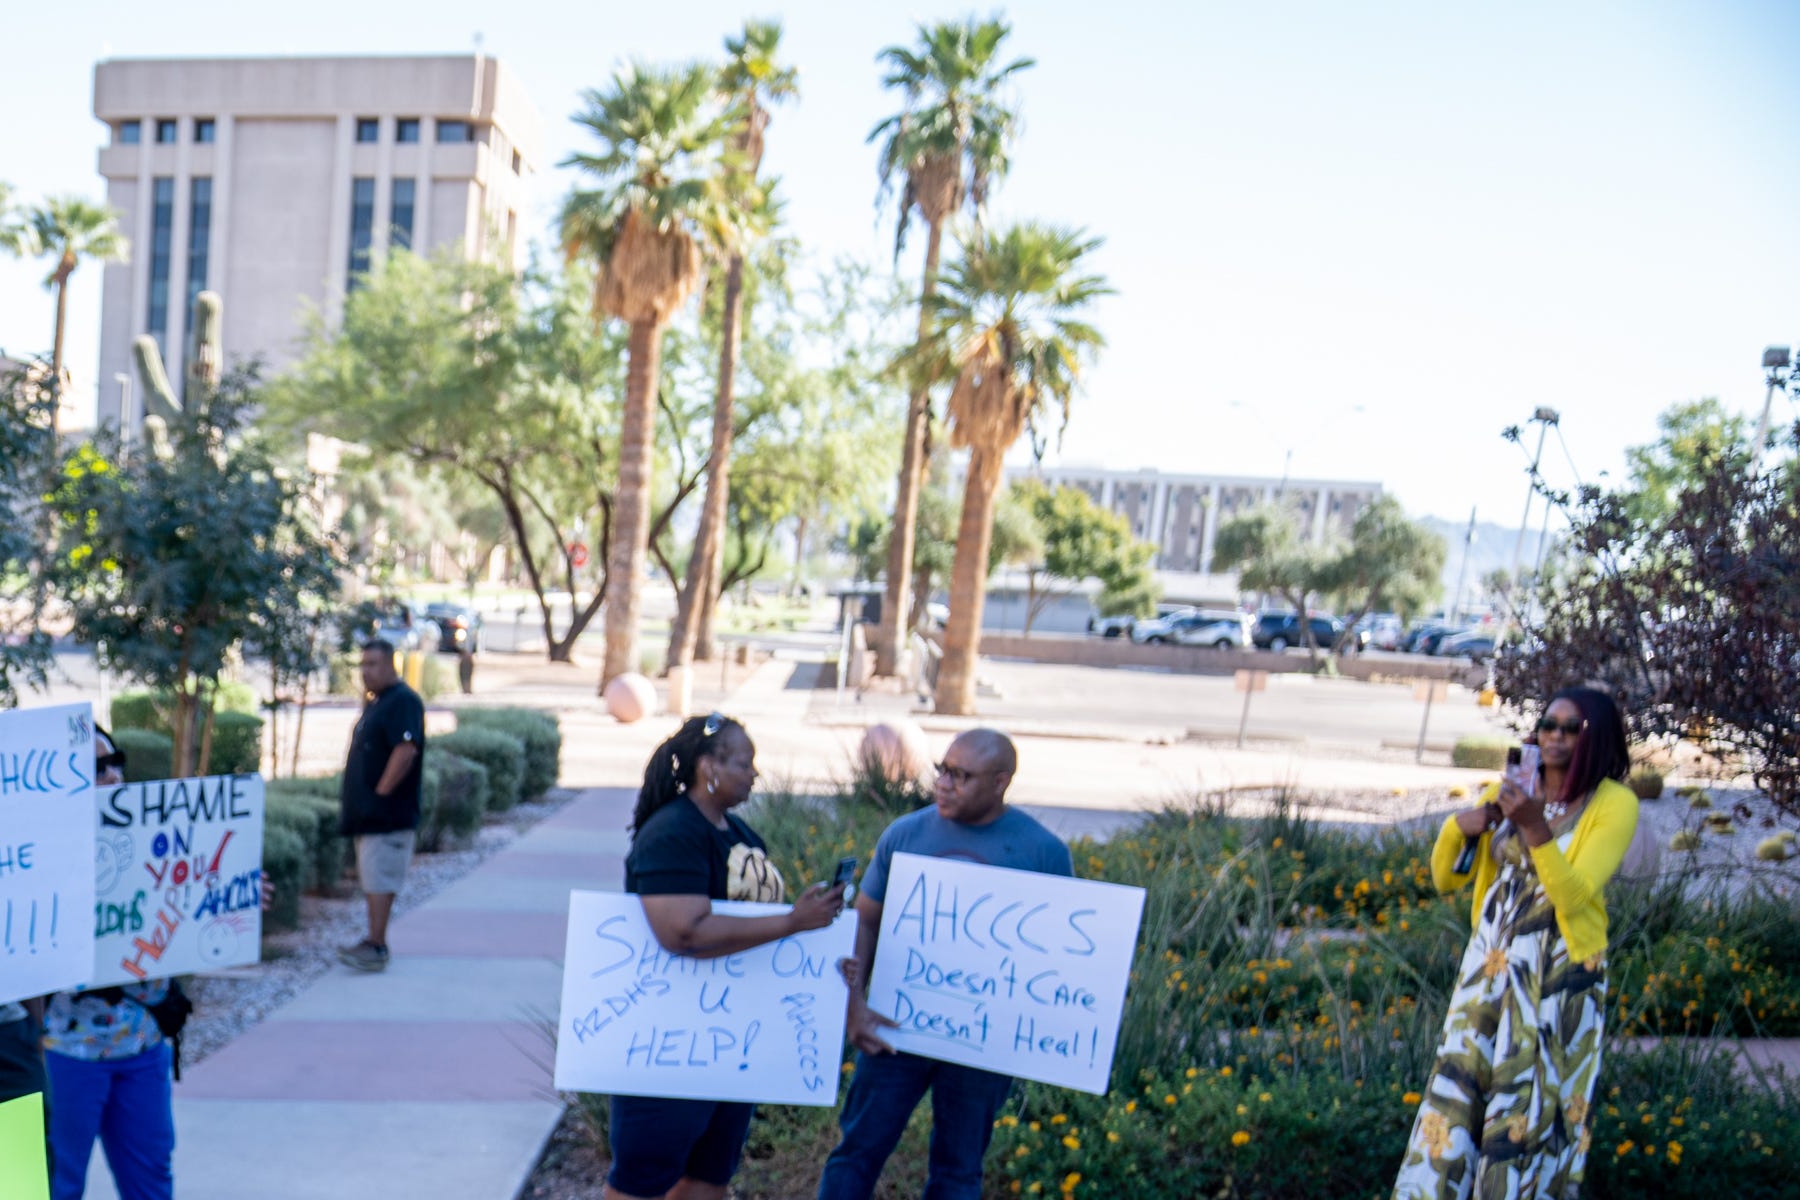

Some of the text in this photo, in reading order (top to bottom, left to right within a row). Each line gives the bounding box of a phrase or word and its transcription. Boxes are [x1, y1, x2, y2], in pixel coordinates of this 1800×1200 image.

[101, 774, 253, 828] SHAME
[152, 824, 194, 858] ON
[892, 871, 1097, 956] AHCCCS
[903, 946, 1018, 999] Doesn't
[572, 972, 671, 1044] AZDHS
[894, 988, 991, 1044] Doesn't
[626, 1018, 761, 1071] HELP!
